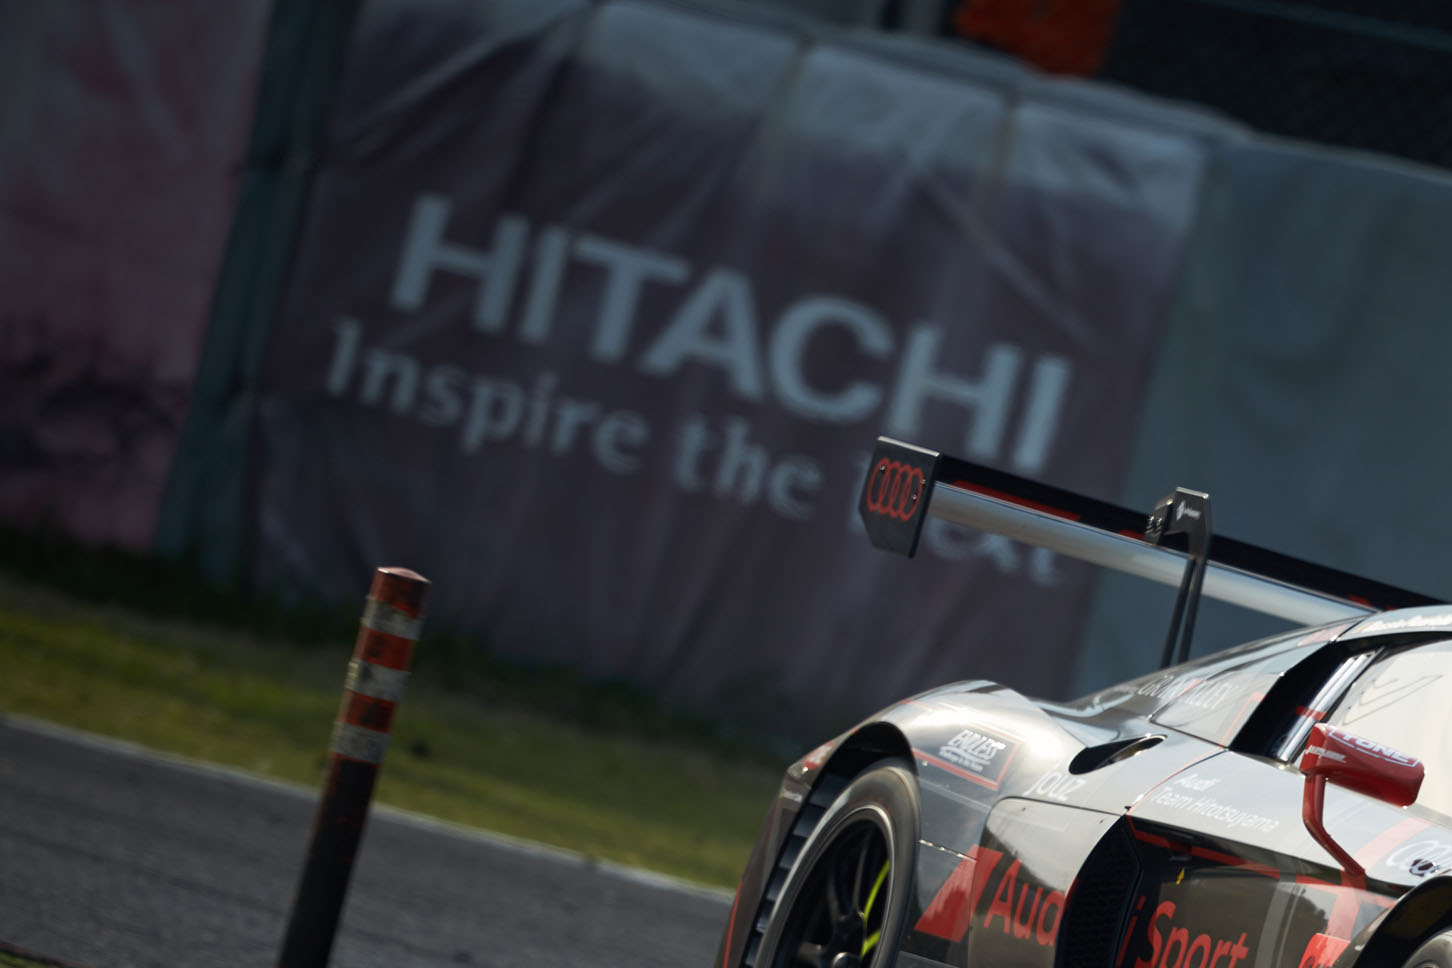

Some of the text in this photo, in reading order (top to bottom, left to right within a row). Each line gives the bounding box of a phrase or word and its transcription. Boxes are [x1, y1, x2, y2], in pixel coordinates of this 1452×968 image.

[326, 318, 648, 474] Inspire
[676, 415, 822, 520] the
[391, 194, 1070, 471] HITACHI
